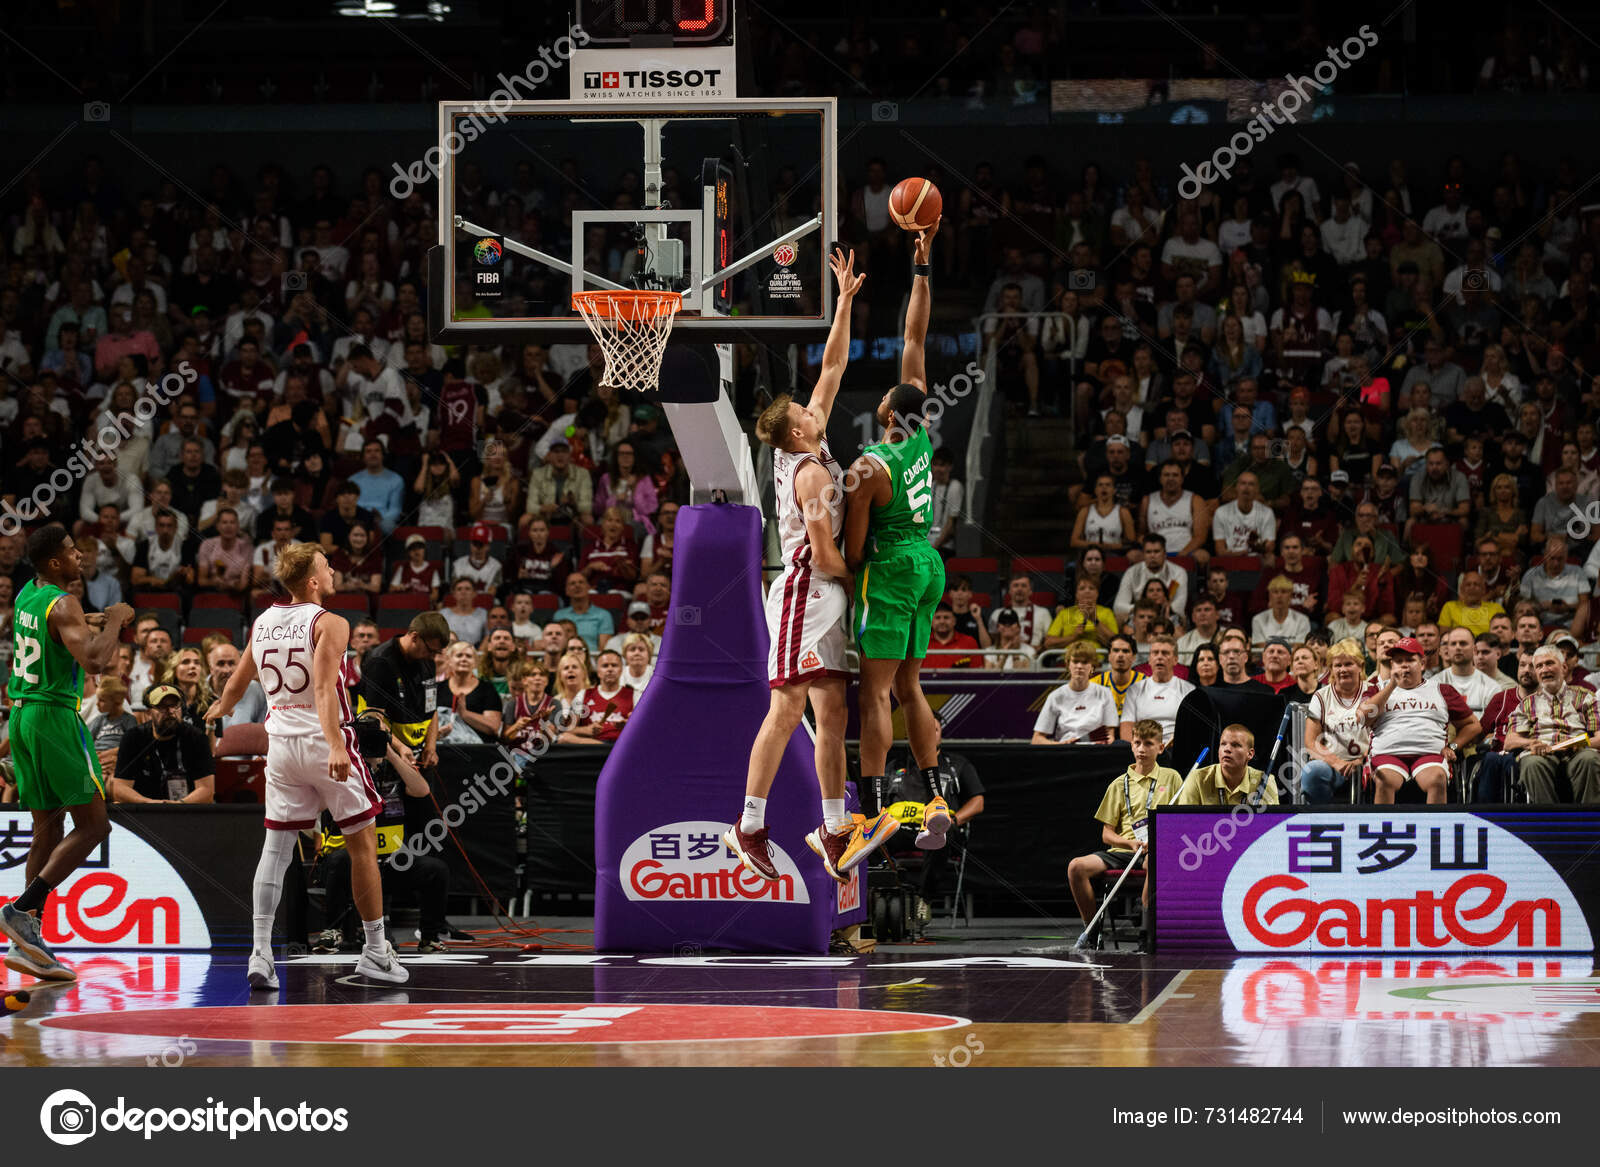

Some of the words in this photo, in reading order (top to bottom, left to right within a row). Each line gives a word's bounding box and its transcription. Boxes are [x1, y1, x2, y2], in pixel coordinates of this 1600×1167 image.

[623, 70, 721, 88] TISSOT
[477, 272, 500, 284] FIBA
[448, 400, 468, 424] 19
[256, 624, 307, 643] ŽAGARS
[13, 632, 41, 684] 32
[261, 647, 310, 696] 55
[1385, 701, 1438, 712] LATVIJA
[1347, 739, 1361, 756] 6
[902, 805, 918, 818] HB
[1285, 820, 1488, 875] 百岁山
[630, 859, 794, 901] Ganten
[1242, 873, 1562, 949] Ganten
